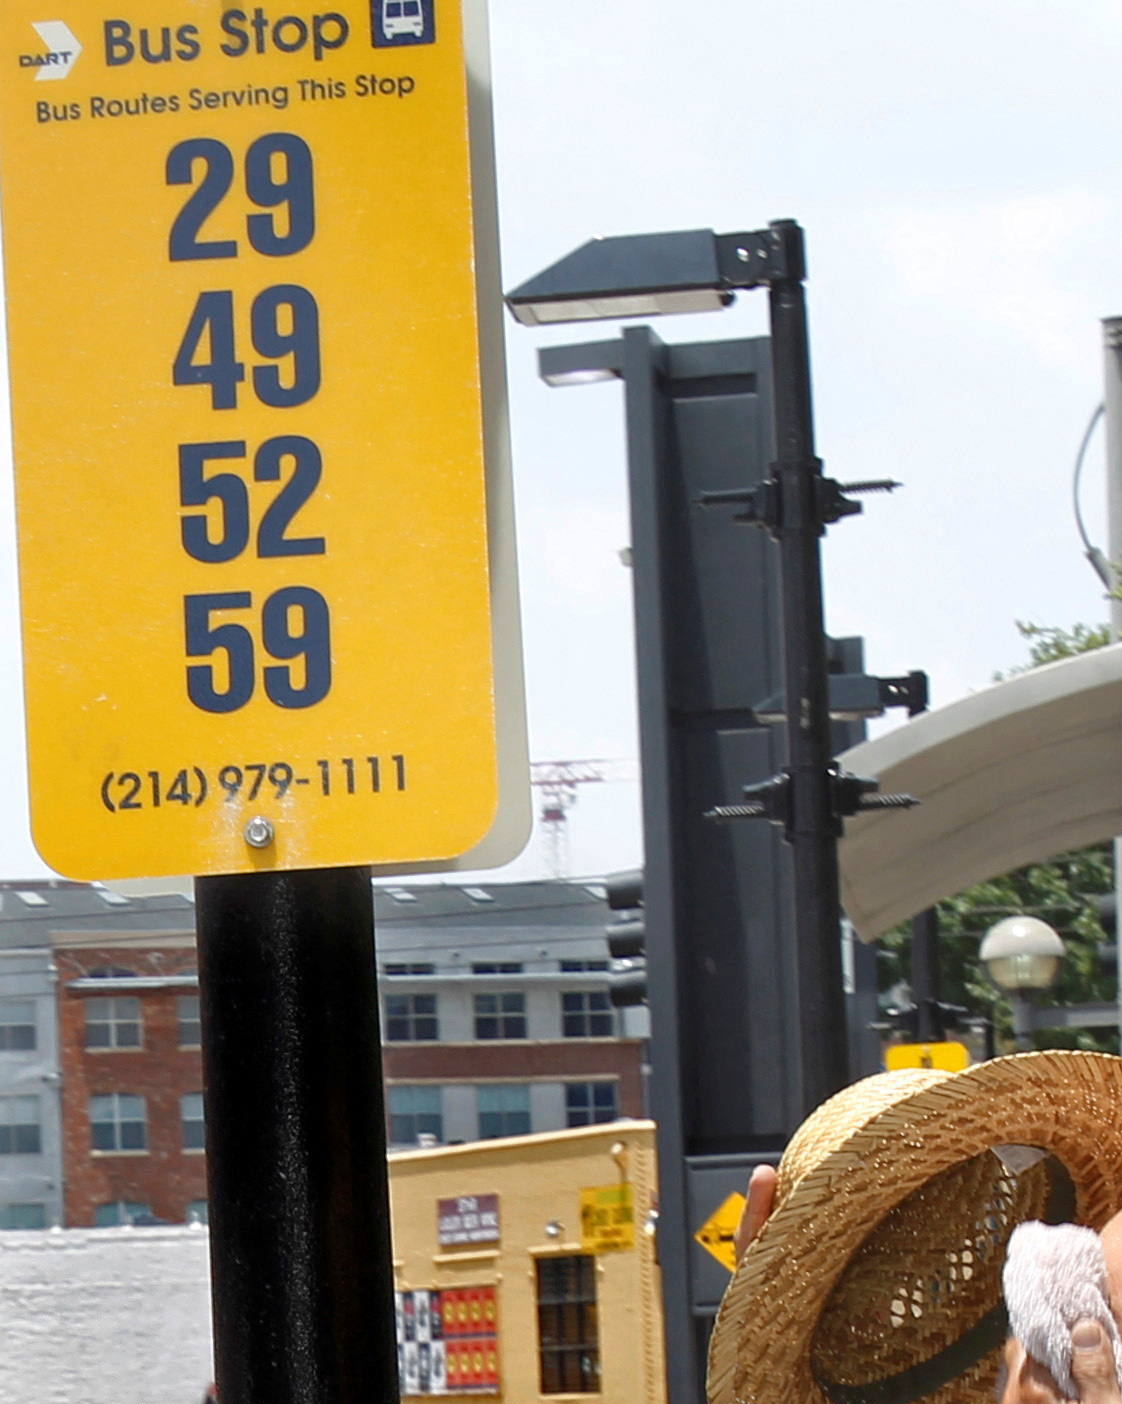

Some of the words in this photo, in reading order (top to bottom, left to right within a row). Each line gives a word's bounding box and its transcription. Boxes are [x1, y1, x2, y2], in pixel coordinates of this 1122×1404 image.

[19, 51, 72, 67] DART
[104, 19, 200, 67] Bus
[220, 8, 349, 61] Stop
[37, 101, 81, 123] Bus
[91, 93, 180, 118] Routes
[189, 84, 288, 110] Serving
[298, 78, 346, 101] This
[355, 74, 415, 98] Stop
[165, 132, 315, 262] 29
[172, 284, 321, 411] 49
[178, 435, 326, 564] 52
[183, 586, 332, 714] 59
[101, 766, 208, 813] (214)
[218, 755, 407, 800] 979-1111
